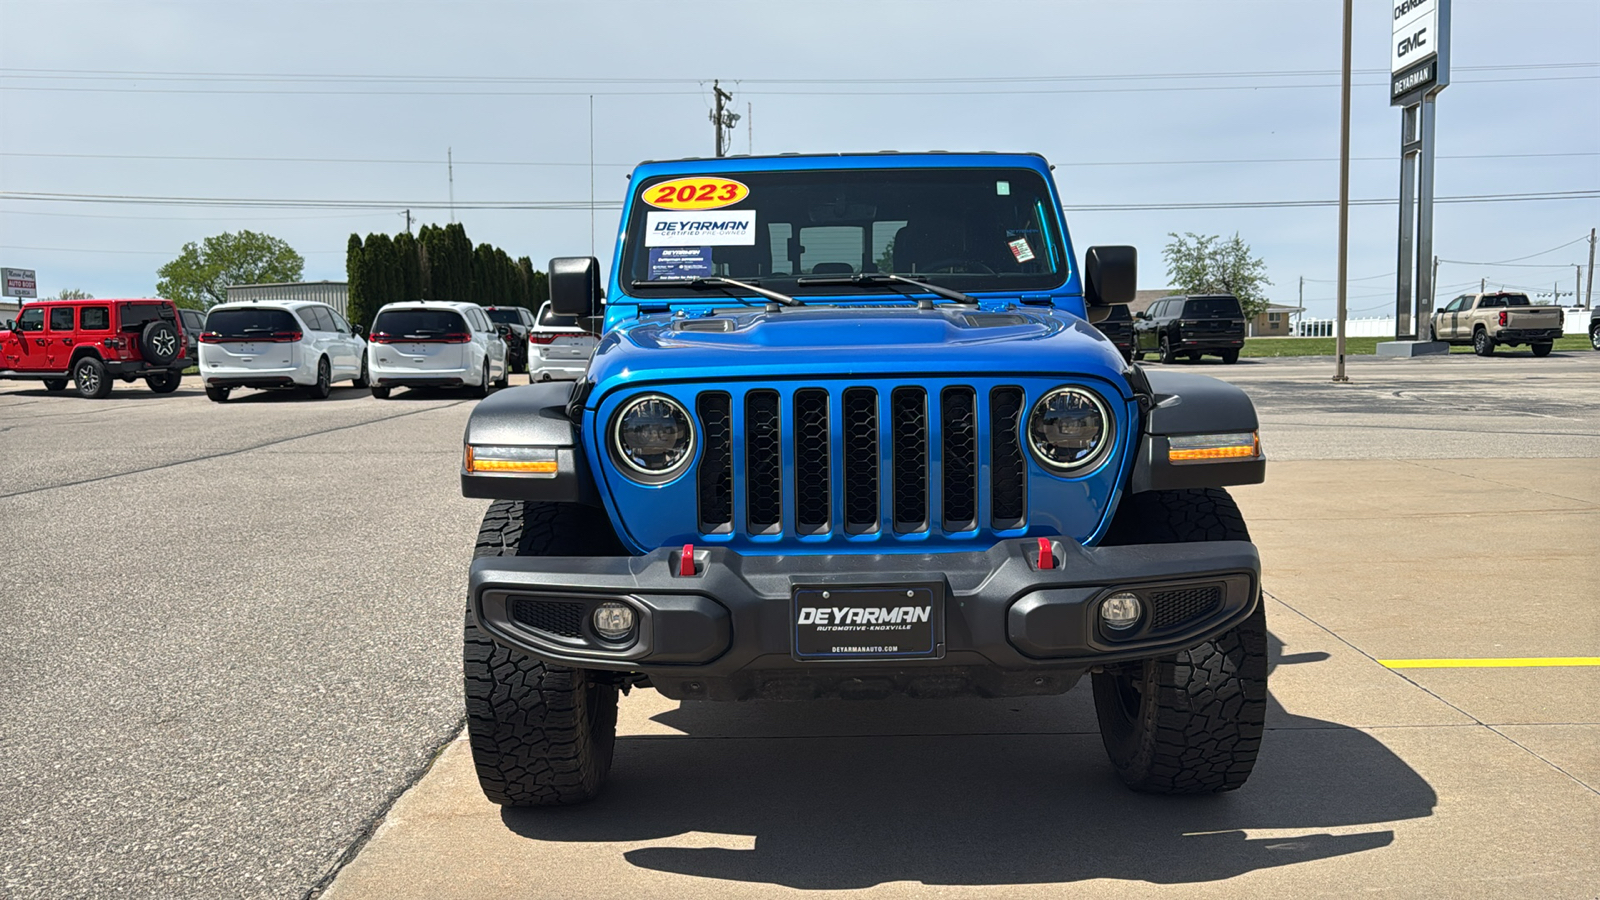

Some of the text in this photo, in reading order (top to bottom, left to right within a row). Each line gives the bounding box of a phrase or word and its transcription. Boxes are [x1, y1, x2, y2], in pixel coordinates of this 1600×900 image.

[1397, 27, 1427, 58] GMC
[1394, 67, 1429, 94] DEYARMAN
[654, 184, 738, 203] 2023
[654, 221, 749, 230] DEYARMAN
[798, 606, 931, 625] DEYARMAN
